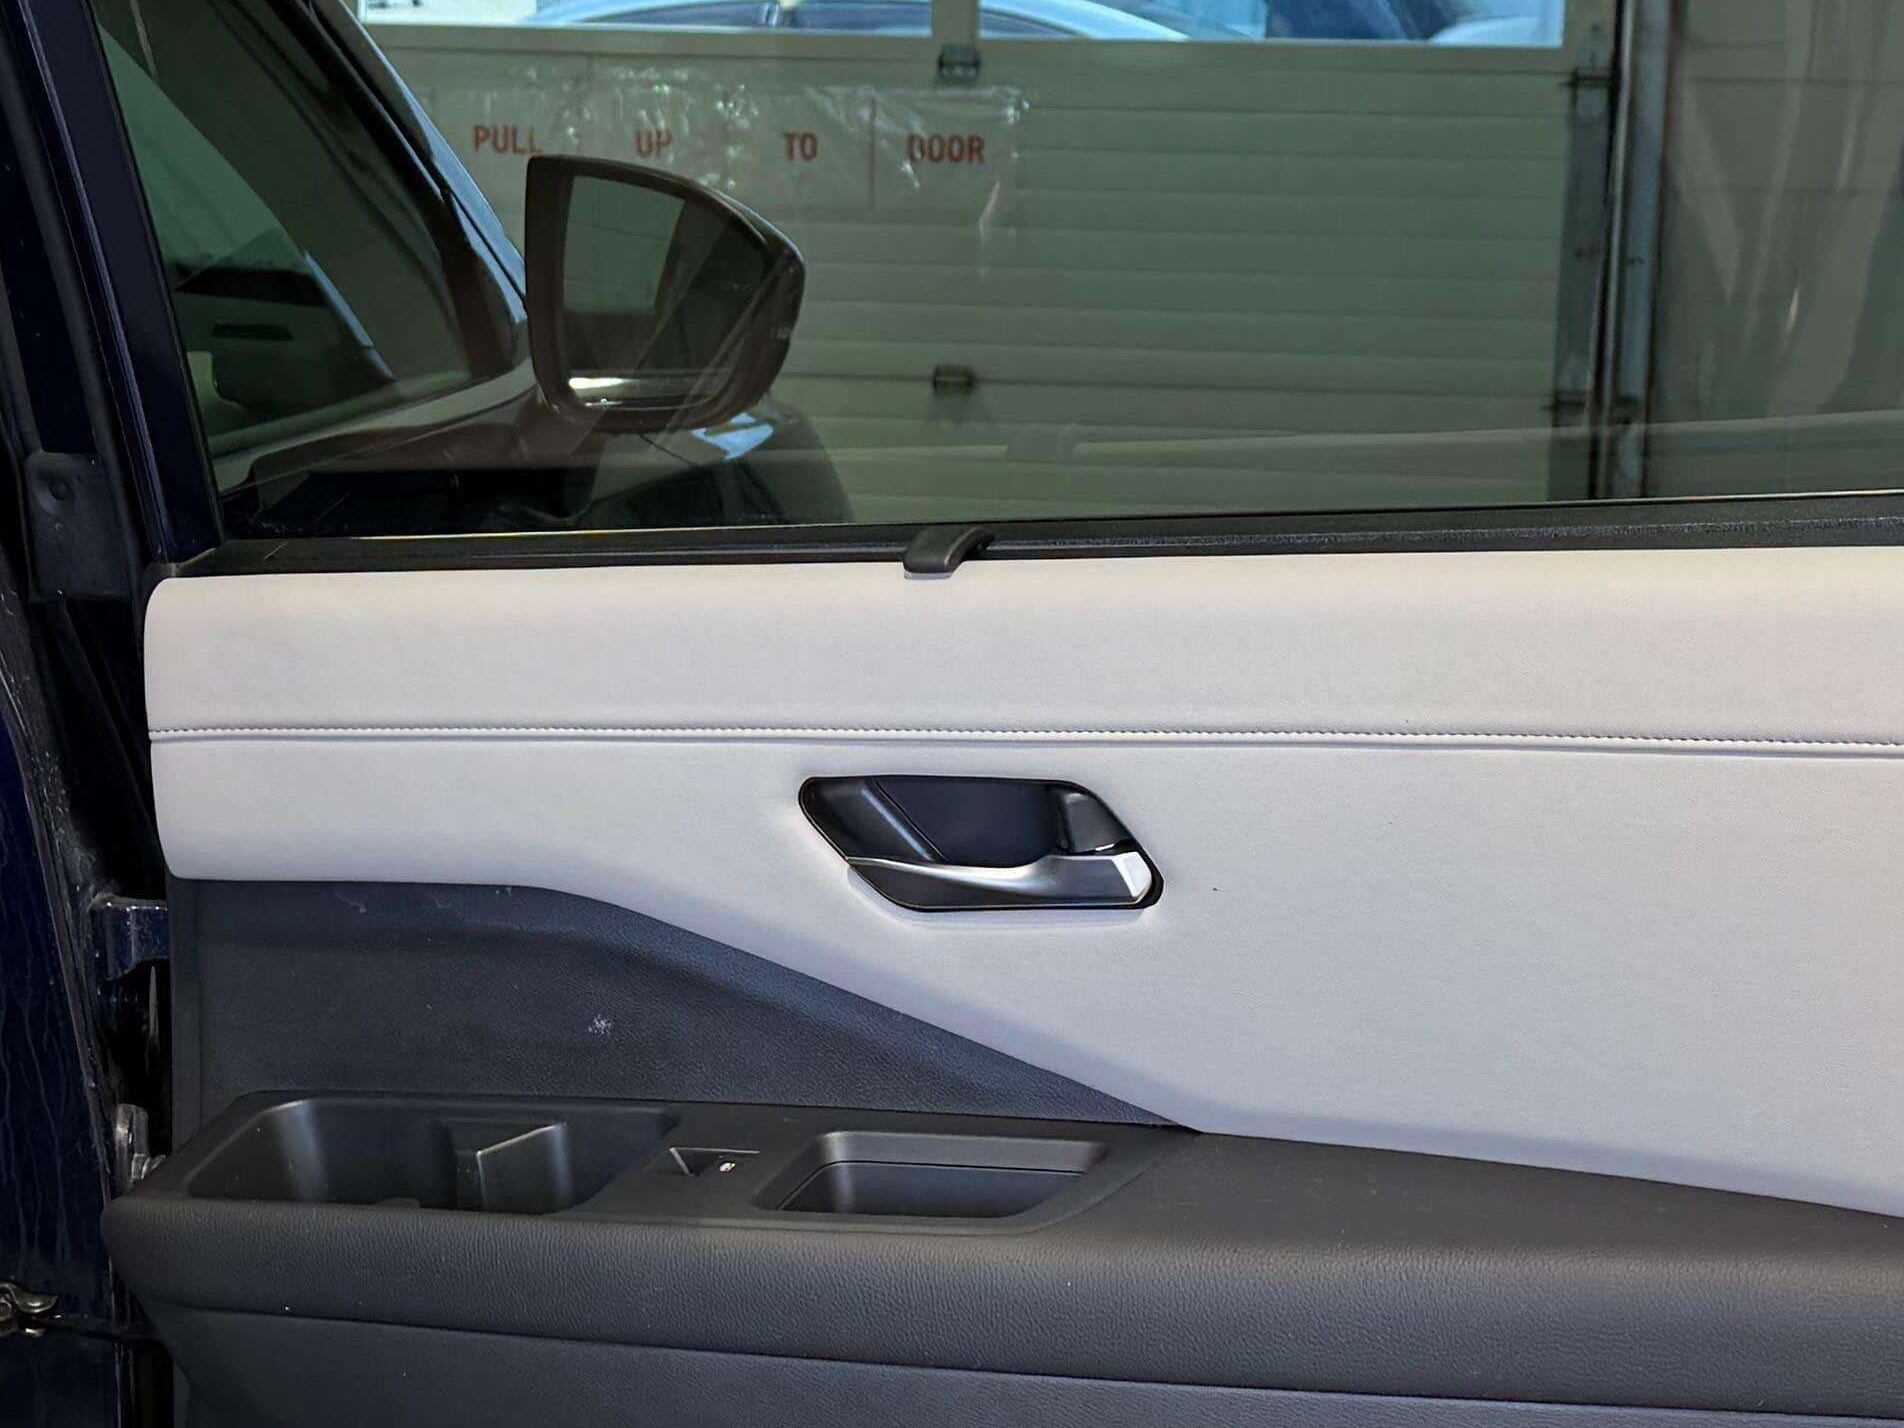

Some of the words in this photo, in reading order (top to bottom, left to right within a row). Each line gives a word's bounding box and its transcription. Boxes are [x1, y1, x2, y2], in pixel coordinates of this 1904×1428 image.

[473, 125, 543, 154] PULL
[634, 129, 672, 157] UP
[784, 132, 818, 162] TO
[907, 133, 986, 164] DOOR
